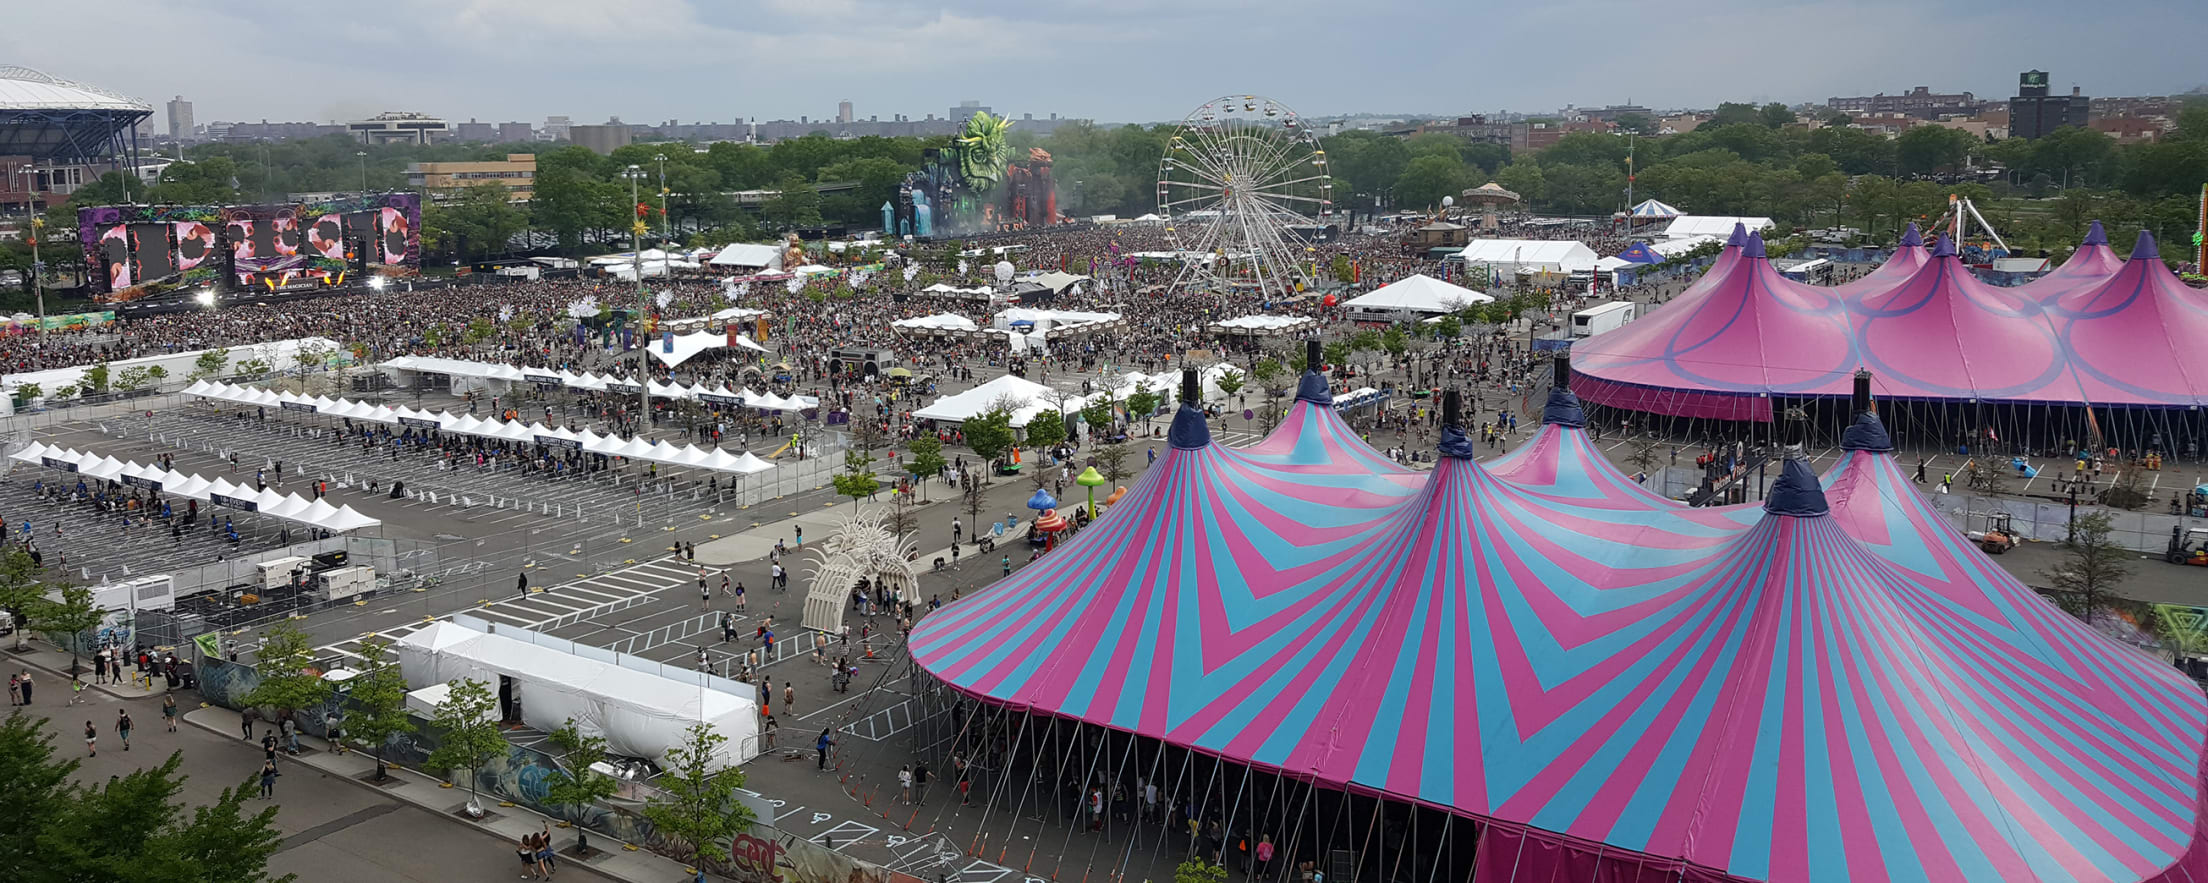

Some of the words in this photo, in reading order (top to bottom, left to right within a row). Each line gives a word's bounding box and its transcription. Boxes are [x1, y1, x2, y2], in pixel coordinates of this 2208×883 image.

[636, 335, 642, 347] B
[610, 384, 629, 392] TICKET
[702, 394, 725, 402] WELCOME
[540, 435, 561, 445] SECURITY
[561, 439, 576, 447] CHECK
[230, 497, 246, 506] EVENT
